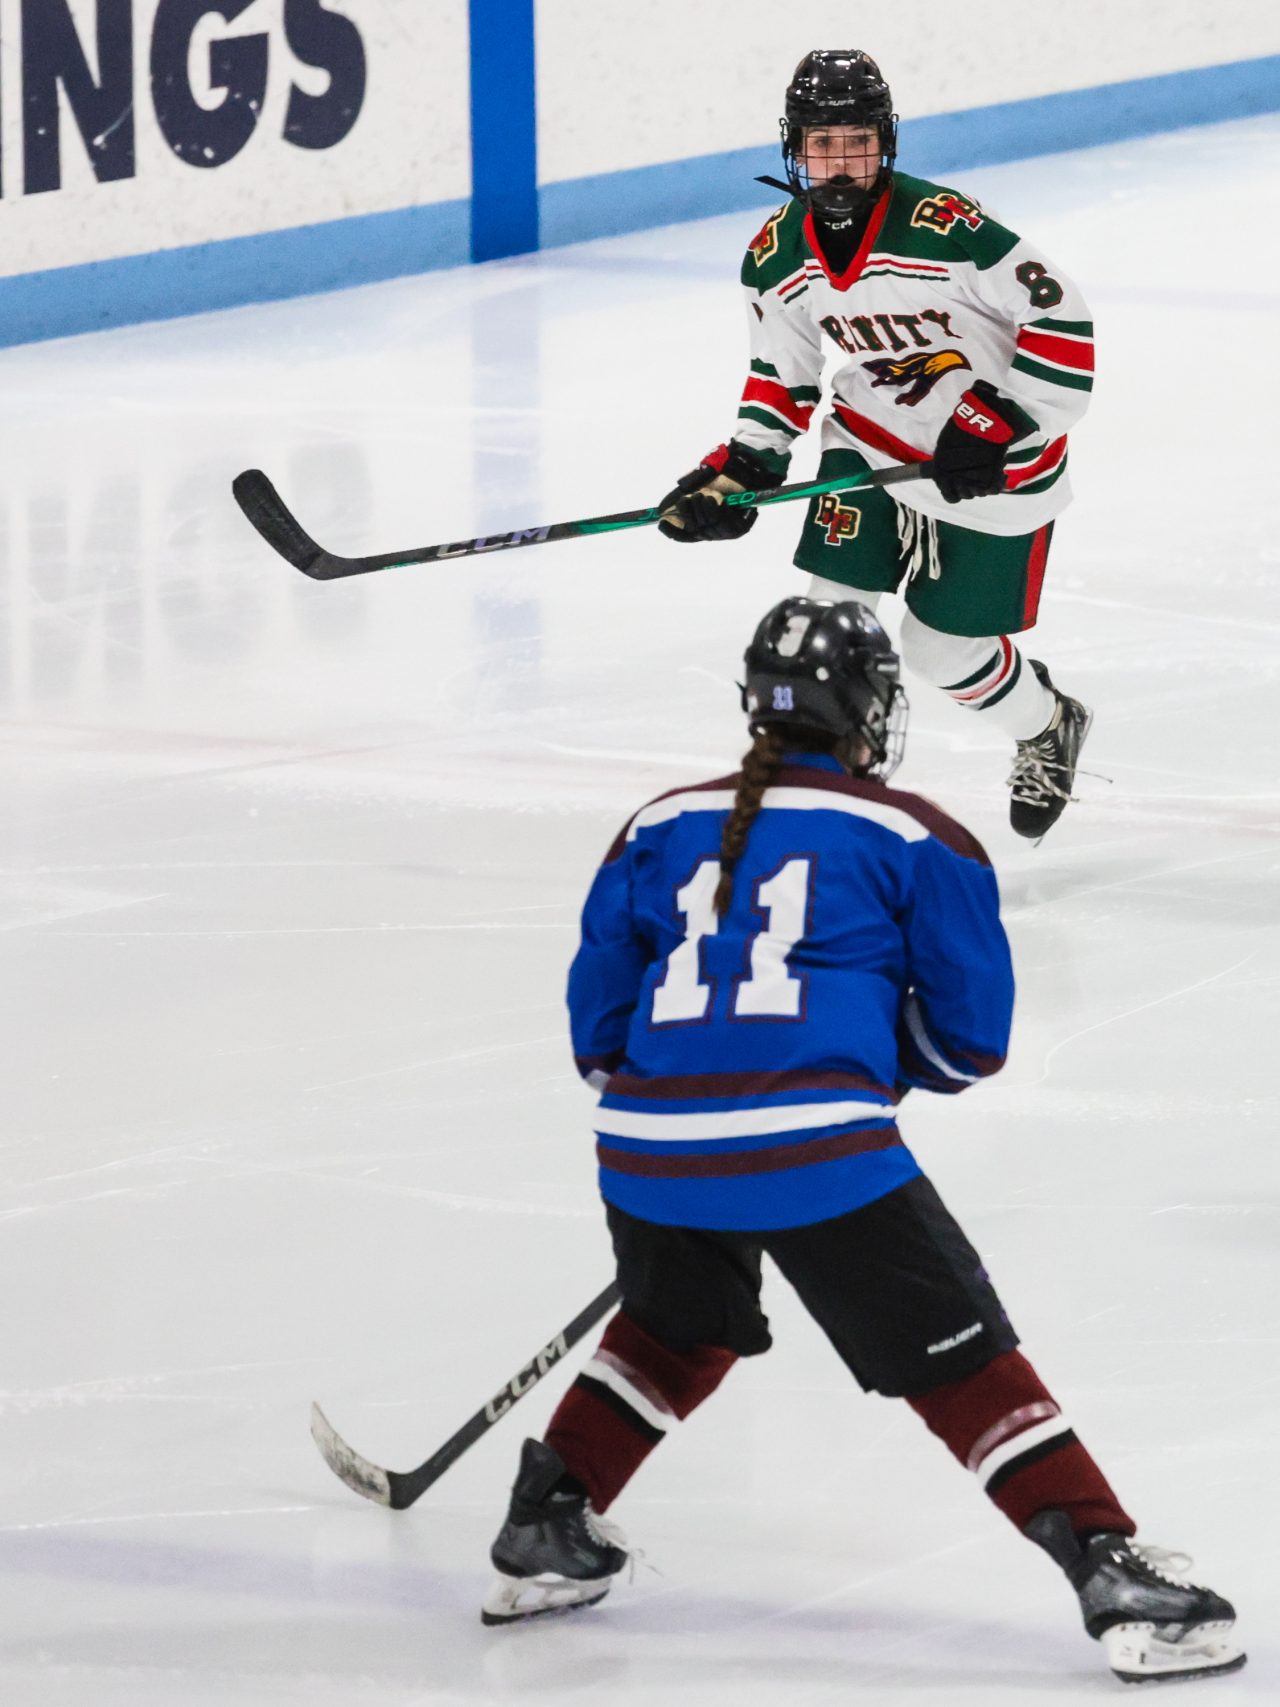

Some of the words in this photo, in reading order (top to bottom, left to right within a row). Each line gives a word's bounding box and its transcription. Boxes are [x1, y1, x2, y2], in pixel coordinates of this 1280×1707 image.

[0, 0, 366, 199] NGS
[825, 217, 853, 231] CM
[648, 852, 818, 1030] 11
[484, 1331, 569, 1424] CCM
